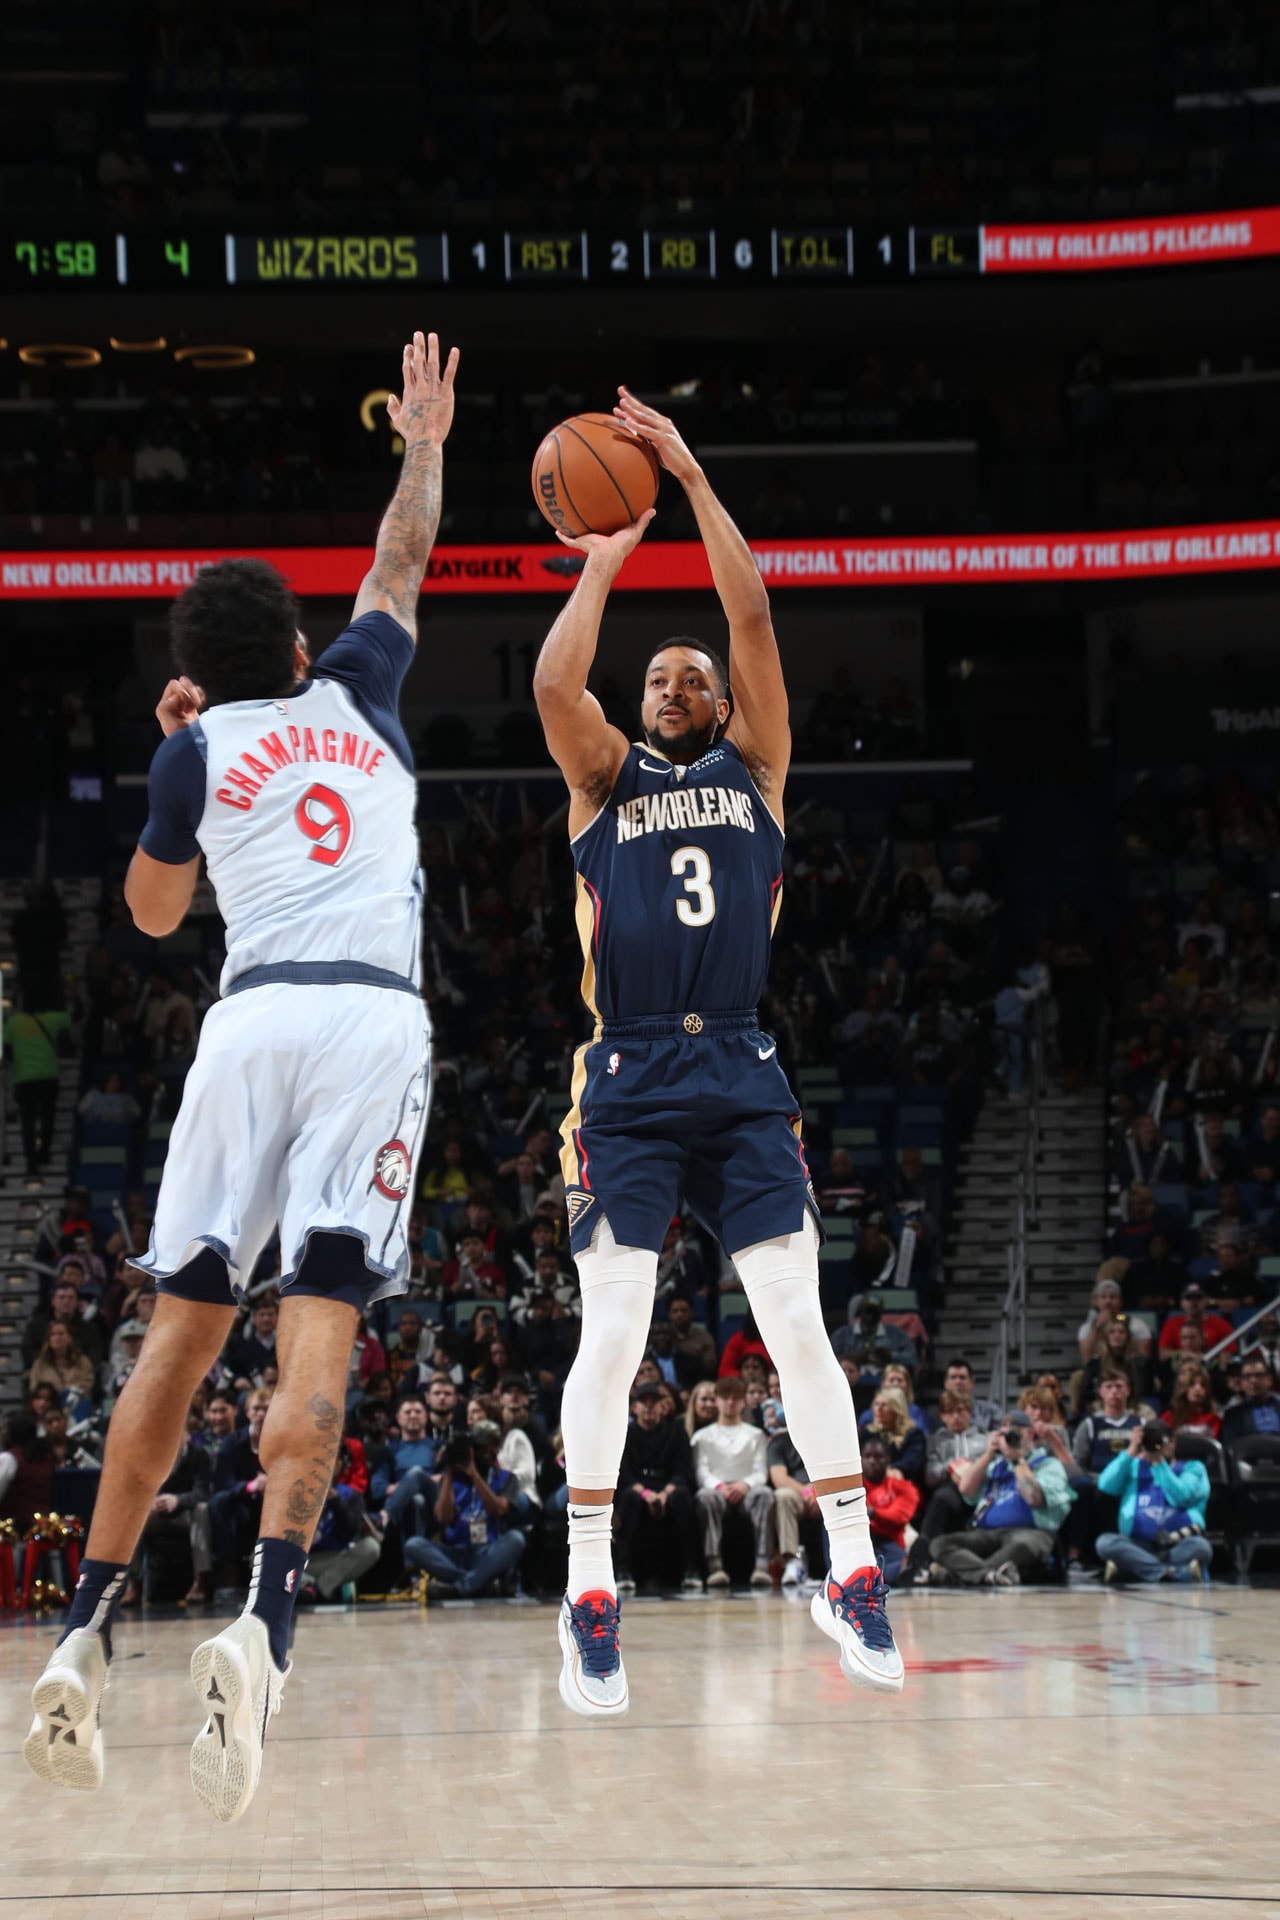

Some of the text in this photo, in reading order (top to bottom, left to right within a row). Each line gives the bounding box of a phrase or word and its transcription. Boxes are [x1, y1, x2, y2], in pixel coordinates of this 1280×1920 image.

[16, 242, 95, 276] 7:58
[165, 241, 189, 277] 4
[257, 238, 417, 279] WIZARDS
[473, 242, 486, 270] 1
[521, 241, 571, 271] AST
[611, 241, 628, 270] 2
[661, 239, 696, 269] RB
[735, 240, 752, 268] 6
[878, 236, 891, 263] 1
[931, 234, 963, 264] FL
[1009, 236, 1054, 261] NEW
[1057, 230, 1151, 259] ORLEANS
[1153, 220, 1252, 253] PELICANS
[3, 563, 51, 587] NEW
[54, 562, 153, 587] ORLEANS
[843, 547, 952, 574] TICKETING
[955, 544, 1048, 571] PARTNER
[1052, 545, 1078, 569] OF
[1081, 543, 1121, 568] THE
[1124, 540, 1172, 565] NEW
[1174, 532, 1271, 563] ORLEANS
[215, 725, 385, 811] CHAMPAGNIE
[295, 782, 355, 868] 9
[670, 846, 716, 927] 3
